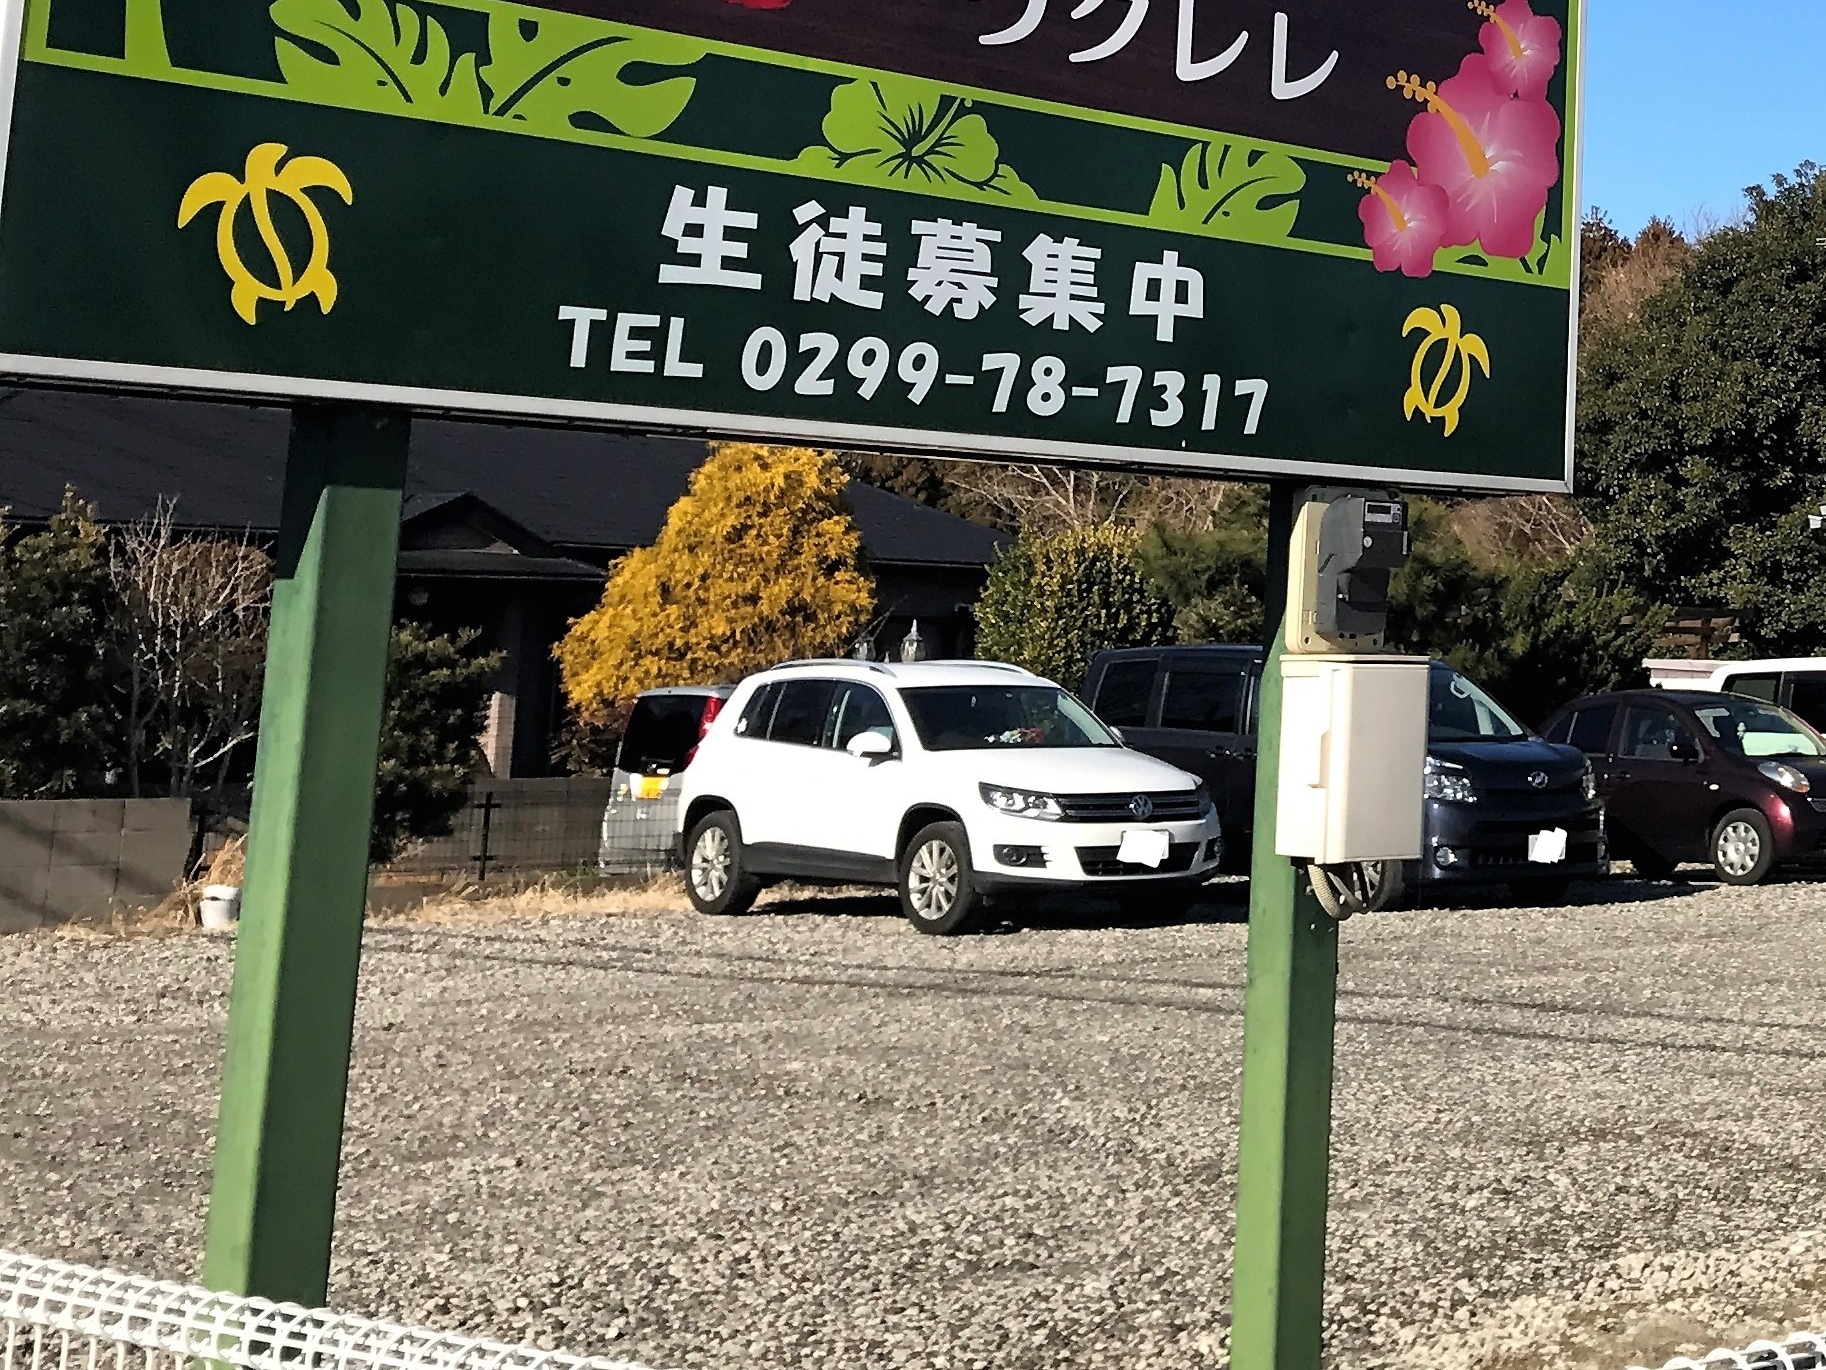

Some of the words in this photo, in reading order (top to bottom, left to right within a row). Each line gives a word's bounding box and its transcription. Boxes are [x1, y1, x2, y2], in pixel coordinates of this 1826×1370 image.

[656, 183, 1206, 344] 生徒募集中
[556, 304, 705, 378] TEL
[740, 325, 1270, 435] 0299-78-7317
